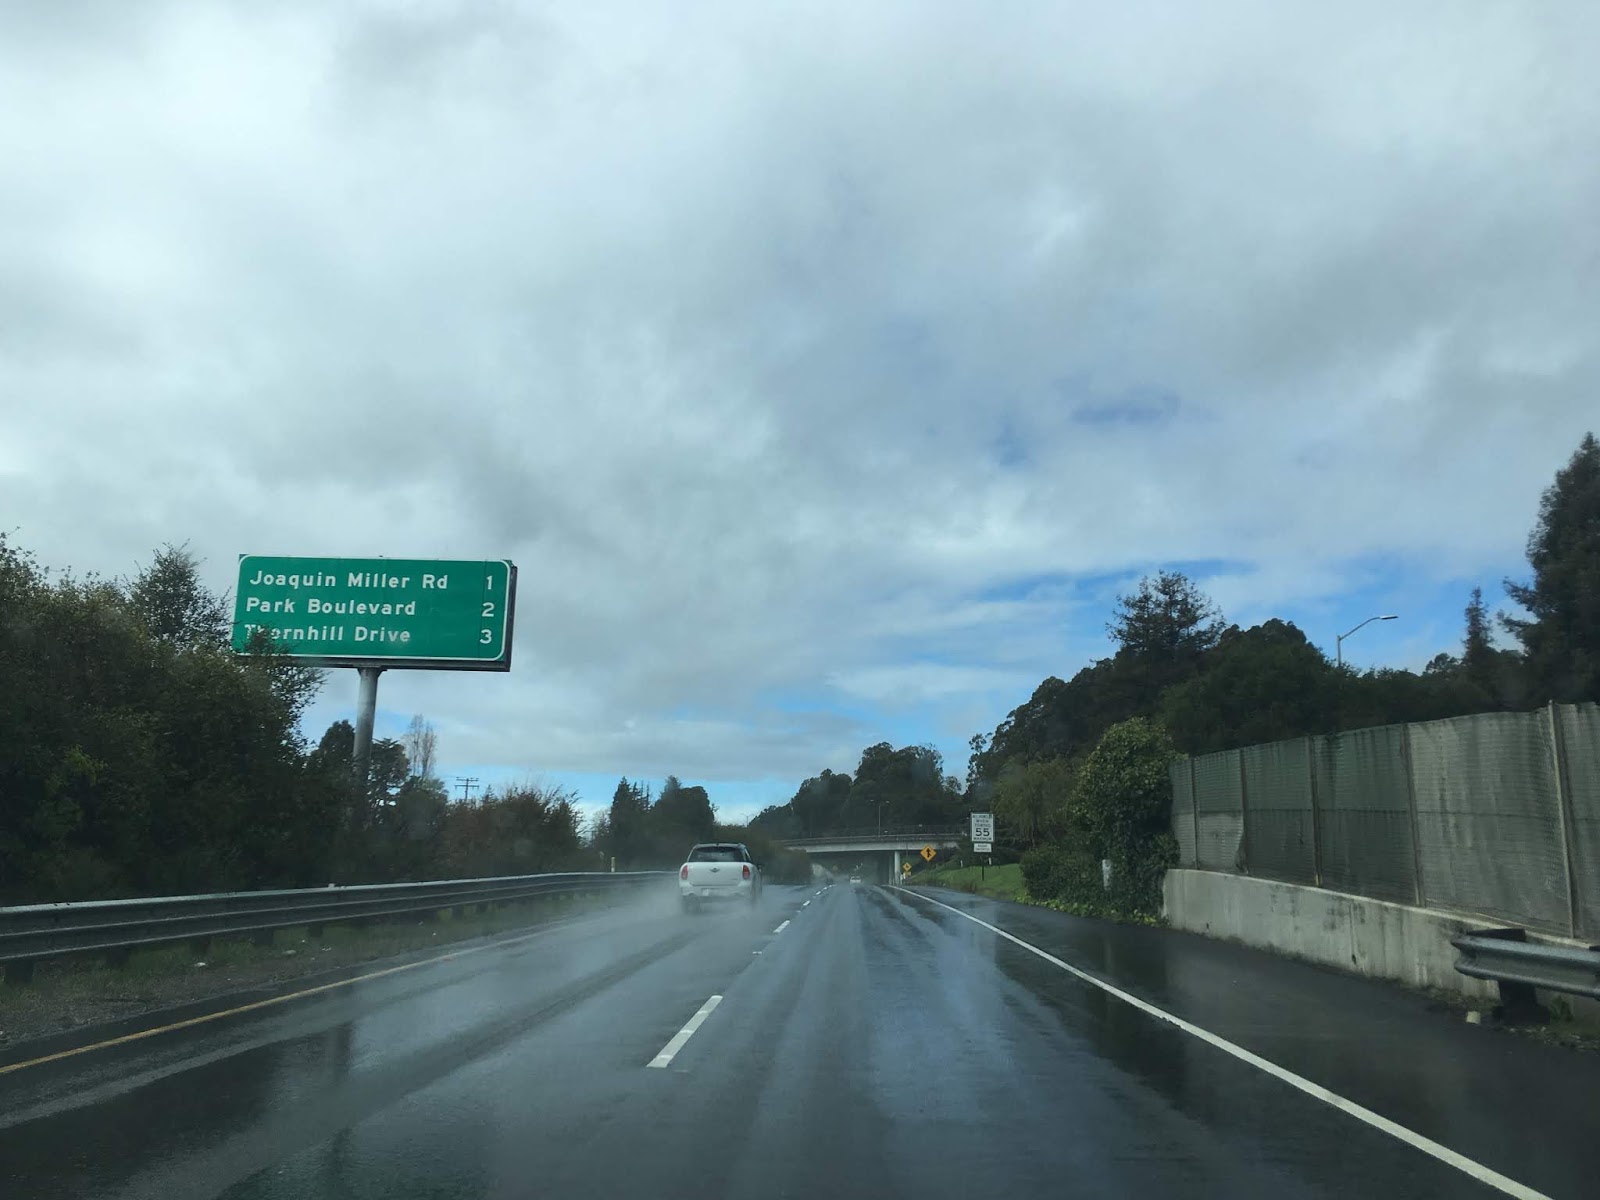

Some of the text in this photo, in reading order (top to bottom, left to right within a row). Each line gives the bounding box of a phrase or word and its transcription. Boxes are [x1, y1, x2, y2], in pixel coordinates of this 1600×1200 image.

[250, 570, 493, 590] Joaquin Miller Rd 1
[246, 597, 495, 617] Park Boulevard 2
[354, 626, 411, 642] Drive
[479, 629, 493, 644] 3
[975, 827, 990, 837] 55
